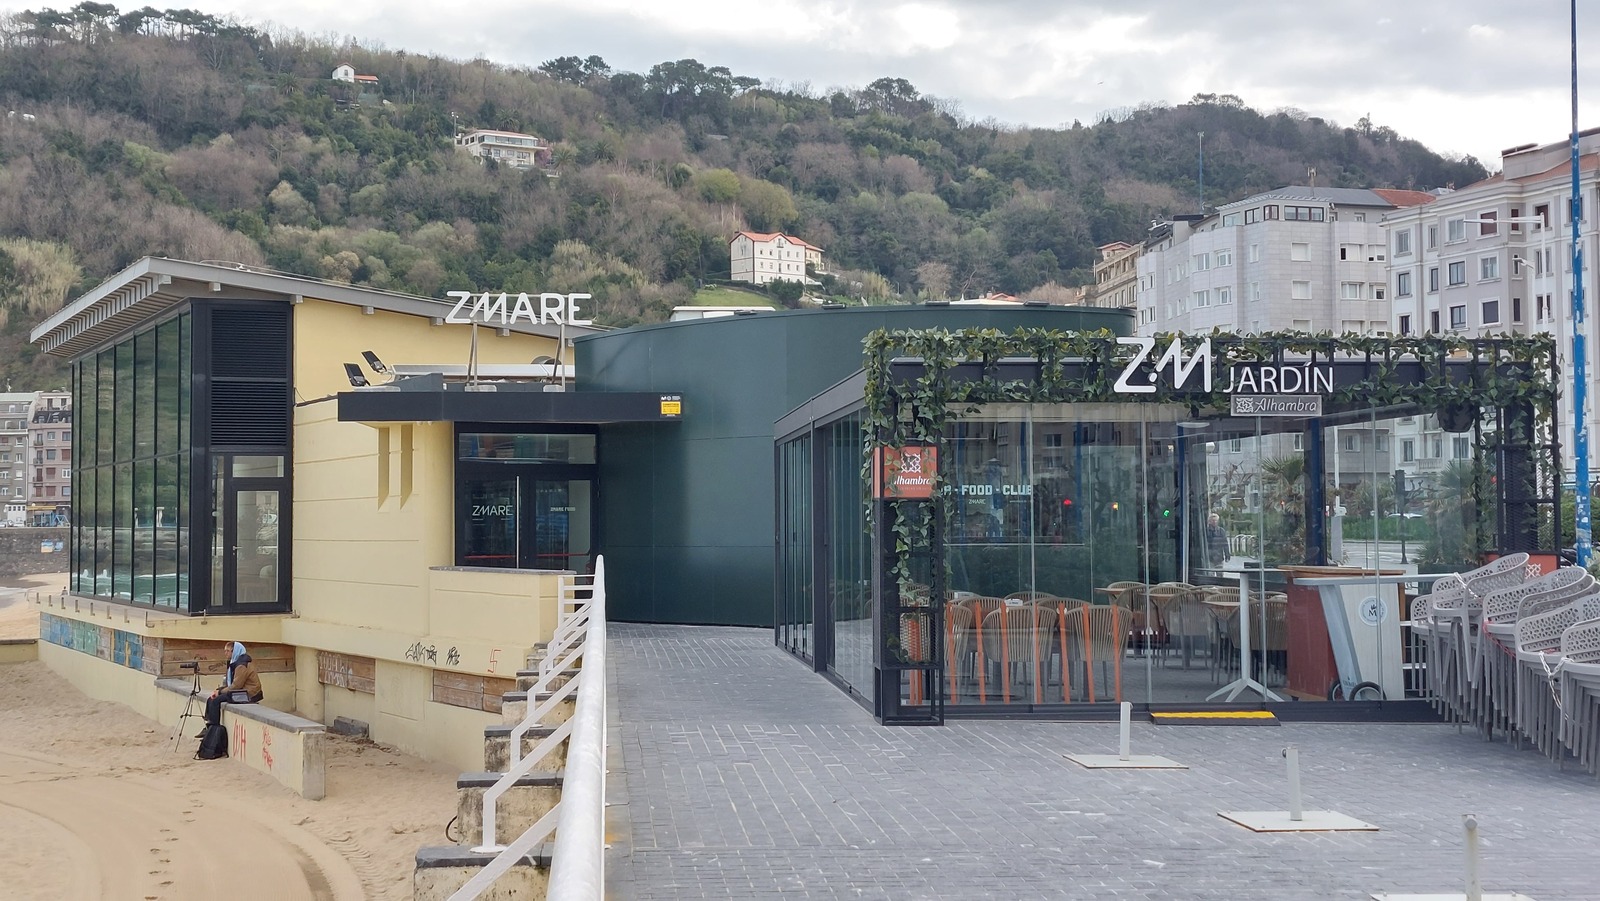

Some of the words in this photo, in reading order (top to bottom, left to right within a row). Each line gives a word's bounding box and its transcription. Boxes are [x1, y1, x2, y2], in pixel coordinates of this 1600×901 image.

[445, 291, 593, 325] ZMARE
[1223, 361, 1334, 393] JARDÍN
[1254, 397, 1318, 413] Alhambra
[893, 476, 931, 485] lhambra
[961, 484, 993, 496] FOOD
[472, 505, 514, 516] ZMARE
